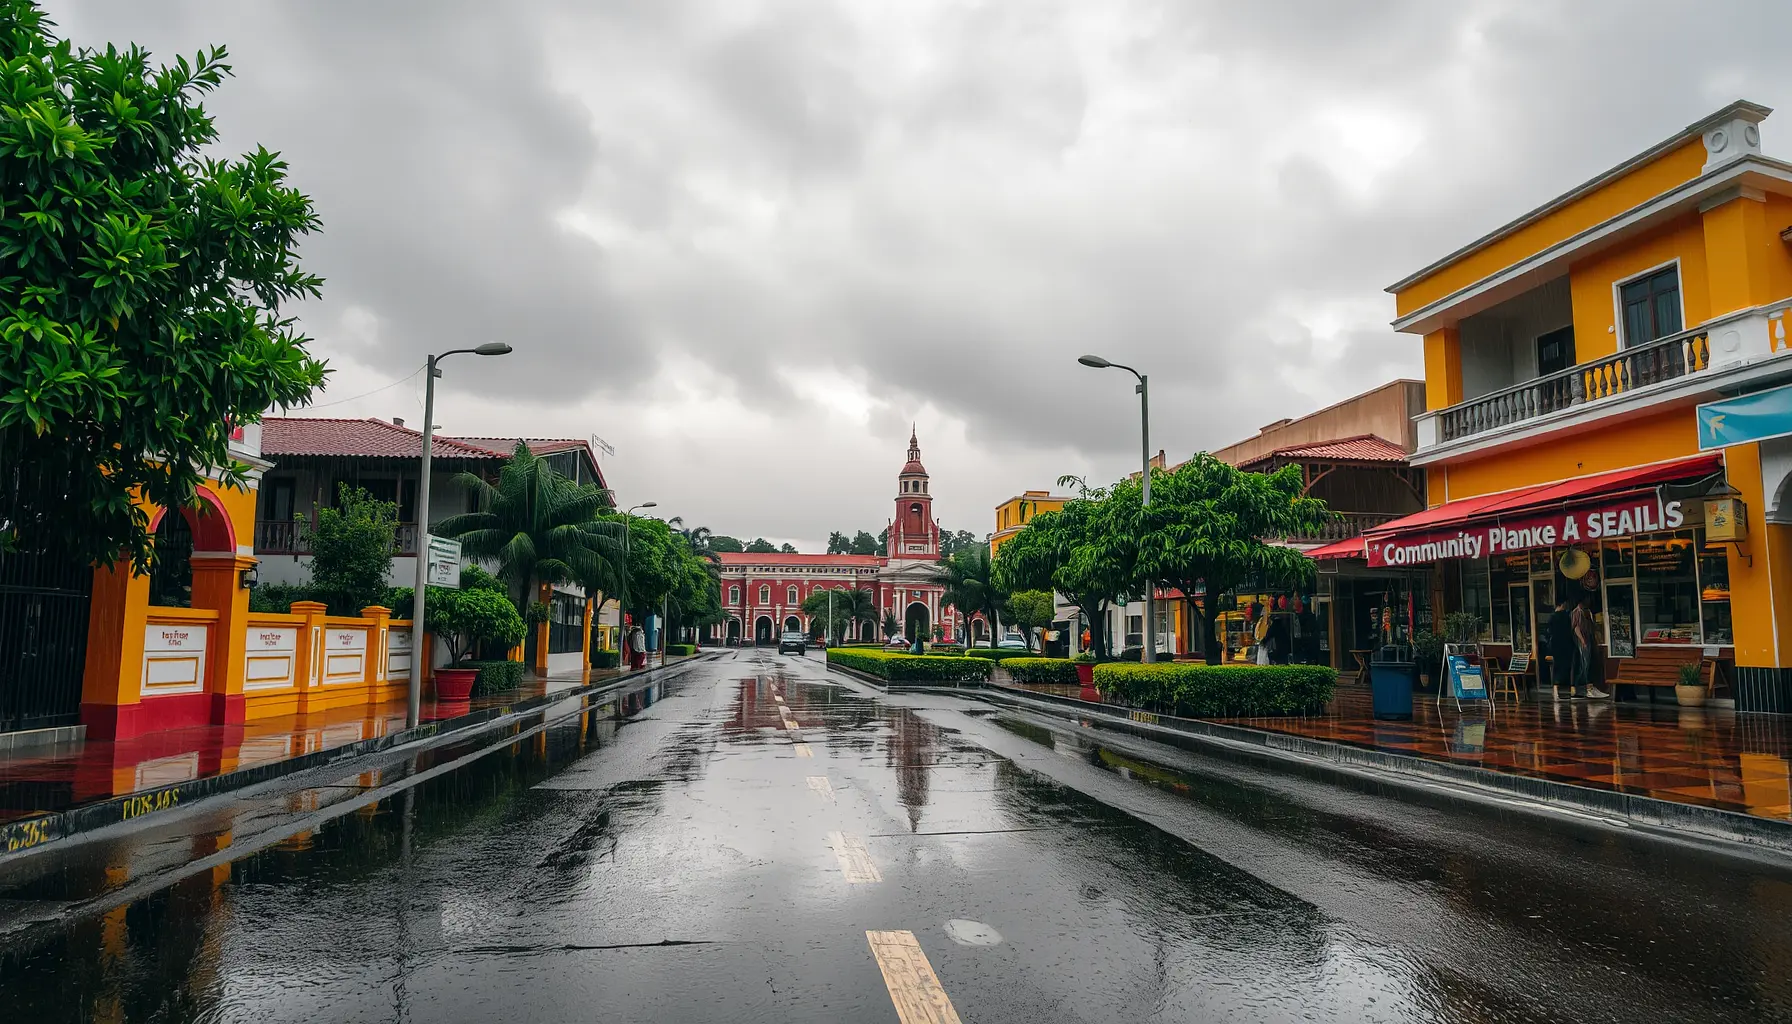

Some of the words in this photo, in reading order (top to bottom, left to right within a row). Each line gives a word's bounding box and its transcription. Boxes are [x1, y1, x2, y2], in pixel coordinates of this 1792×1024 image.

[1384, 531, 1482, 566] Community
[1488, 525, 1557, 553] Planke
[1562, 515, 1581, 541] A
